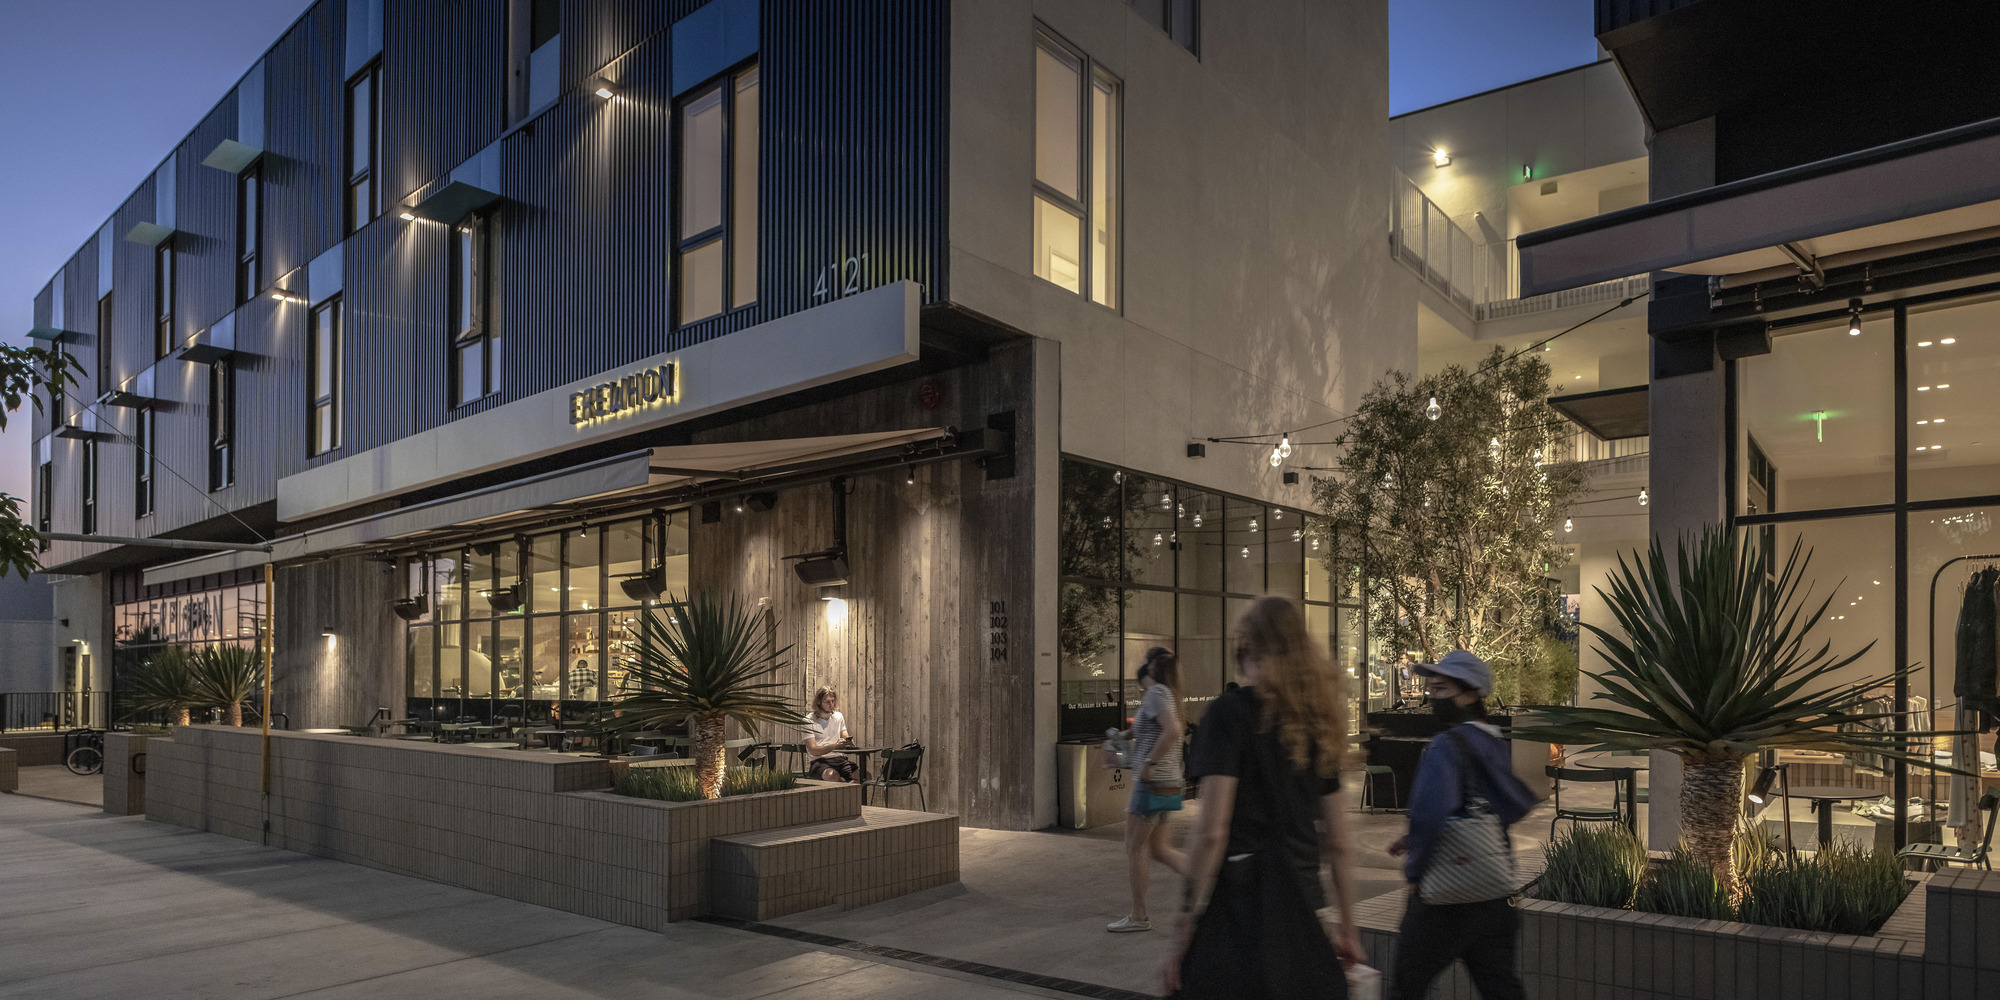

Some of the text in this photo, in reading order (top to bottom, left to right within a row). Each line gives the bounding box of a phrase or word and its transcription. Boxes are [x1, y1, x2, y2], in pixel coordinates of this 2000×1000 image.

[812, 252, 869, 301] 4121
[569, 363, 675, 425] EREWHON
[990, 601, 1005, 614] 101
[150, 592, 222, 641] EREWHON
[990, 616, 1008, 629] 102
[990, 632, 1008, 645] 103
[990, 647, 1008, 661] 104
[1109, 783, 1126, 791] RECYCLE
